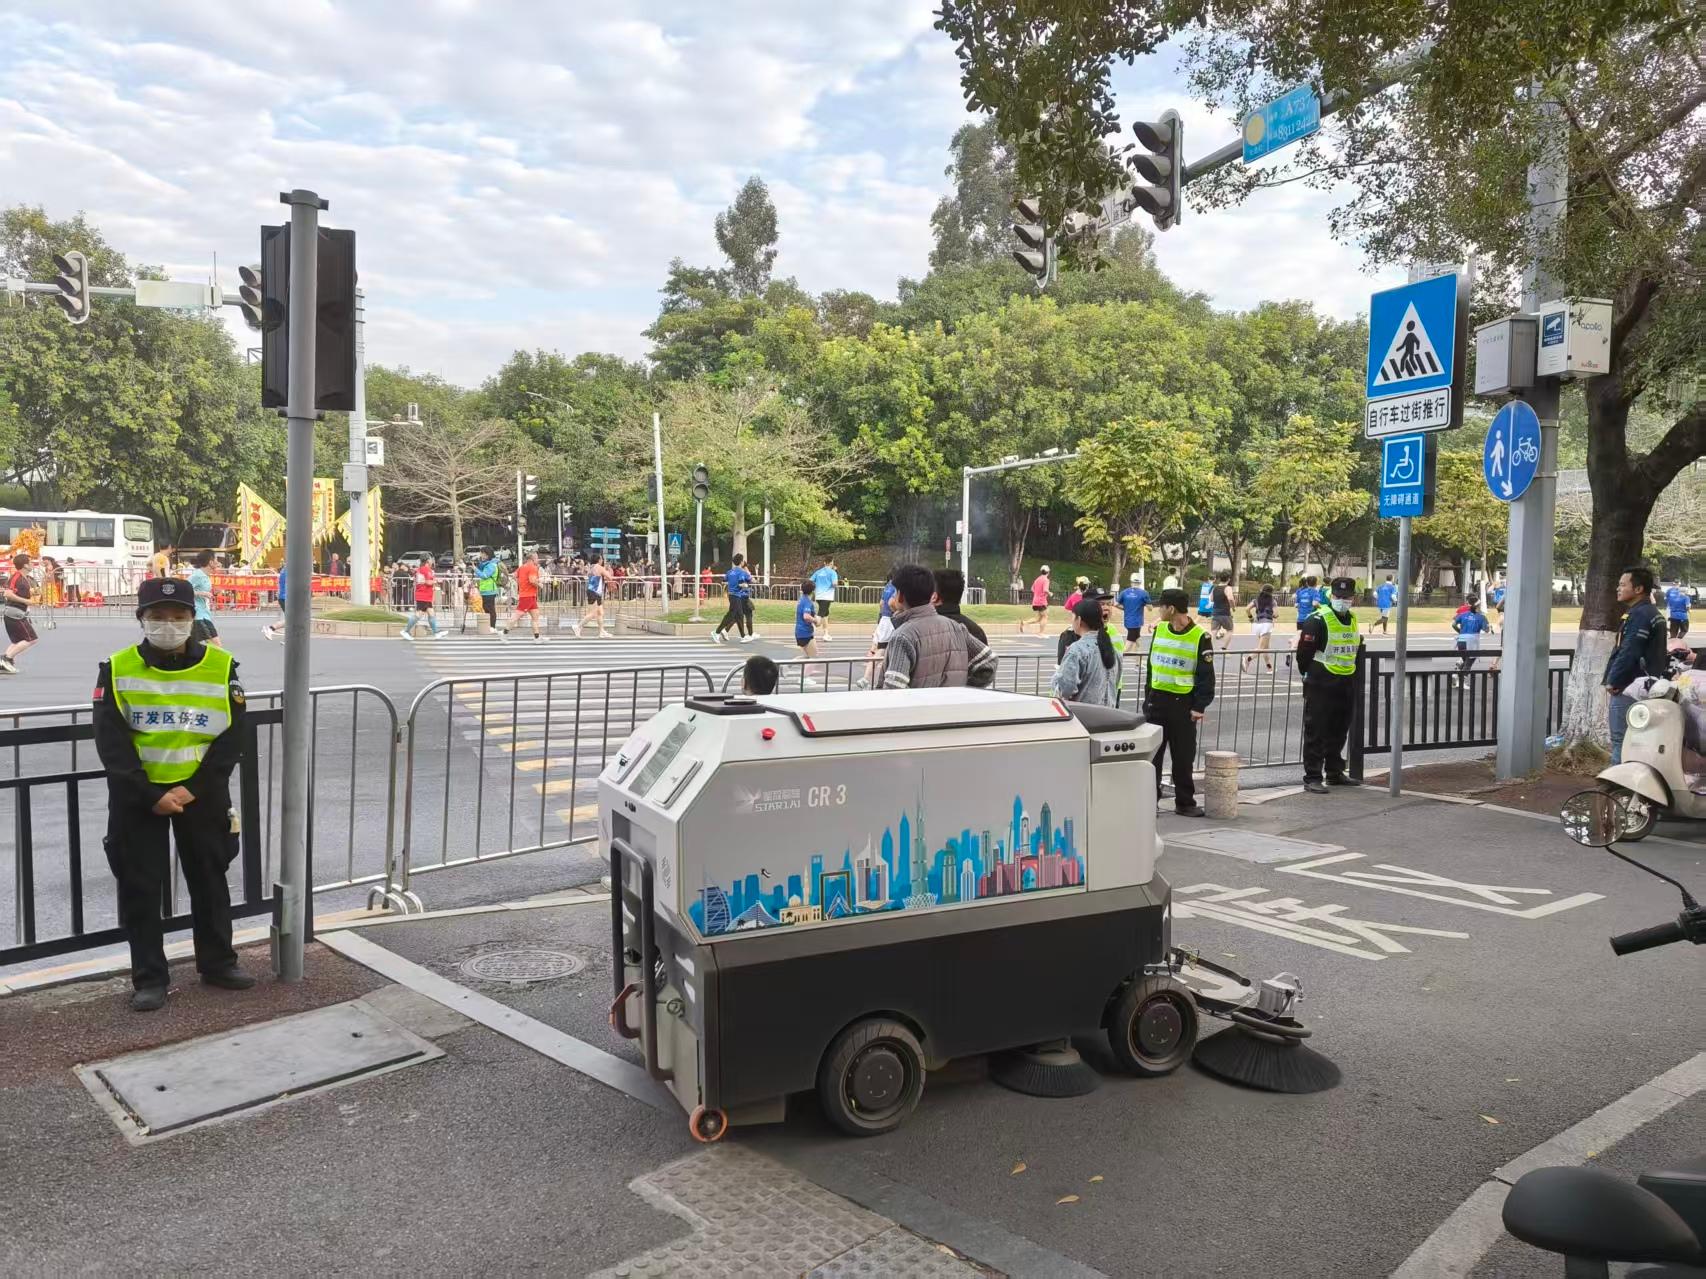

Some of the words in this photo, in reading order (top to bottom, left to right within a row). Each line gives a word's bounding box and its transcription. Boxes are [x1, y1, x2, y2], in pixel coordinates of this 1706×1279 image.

[1370, 397, 1445, 428] 自行车过街推行
[1384, 492, 1419, 506] 无障碍通道
[131, 710, 209, 727] 开发区保安
[808, 785, 831, 808] CR
[835, 784, 847, 805] 3
